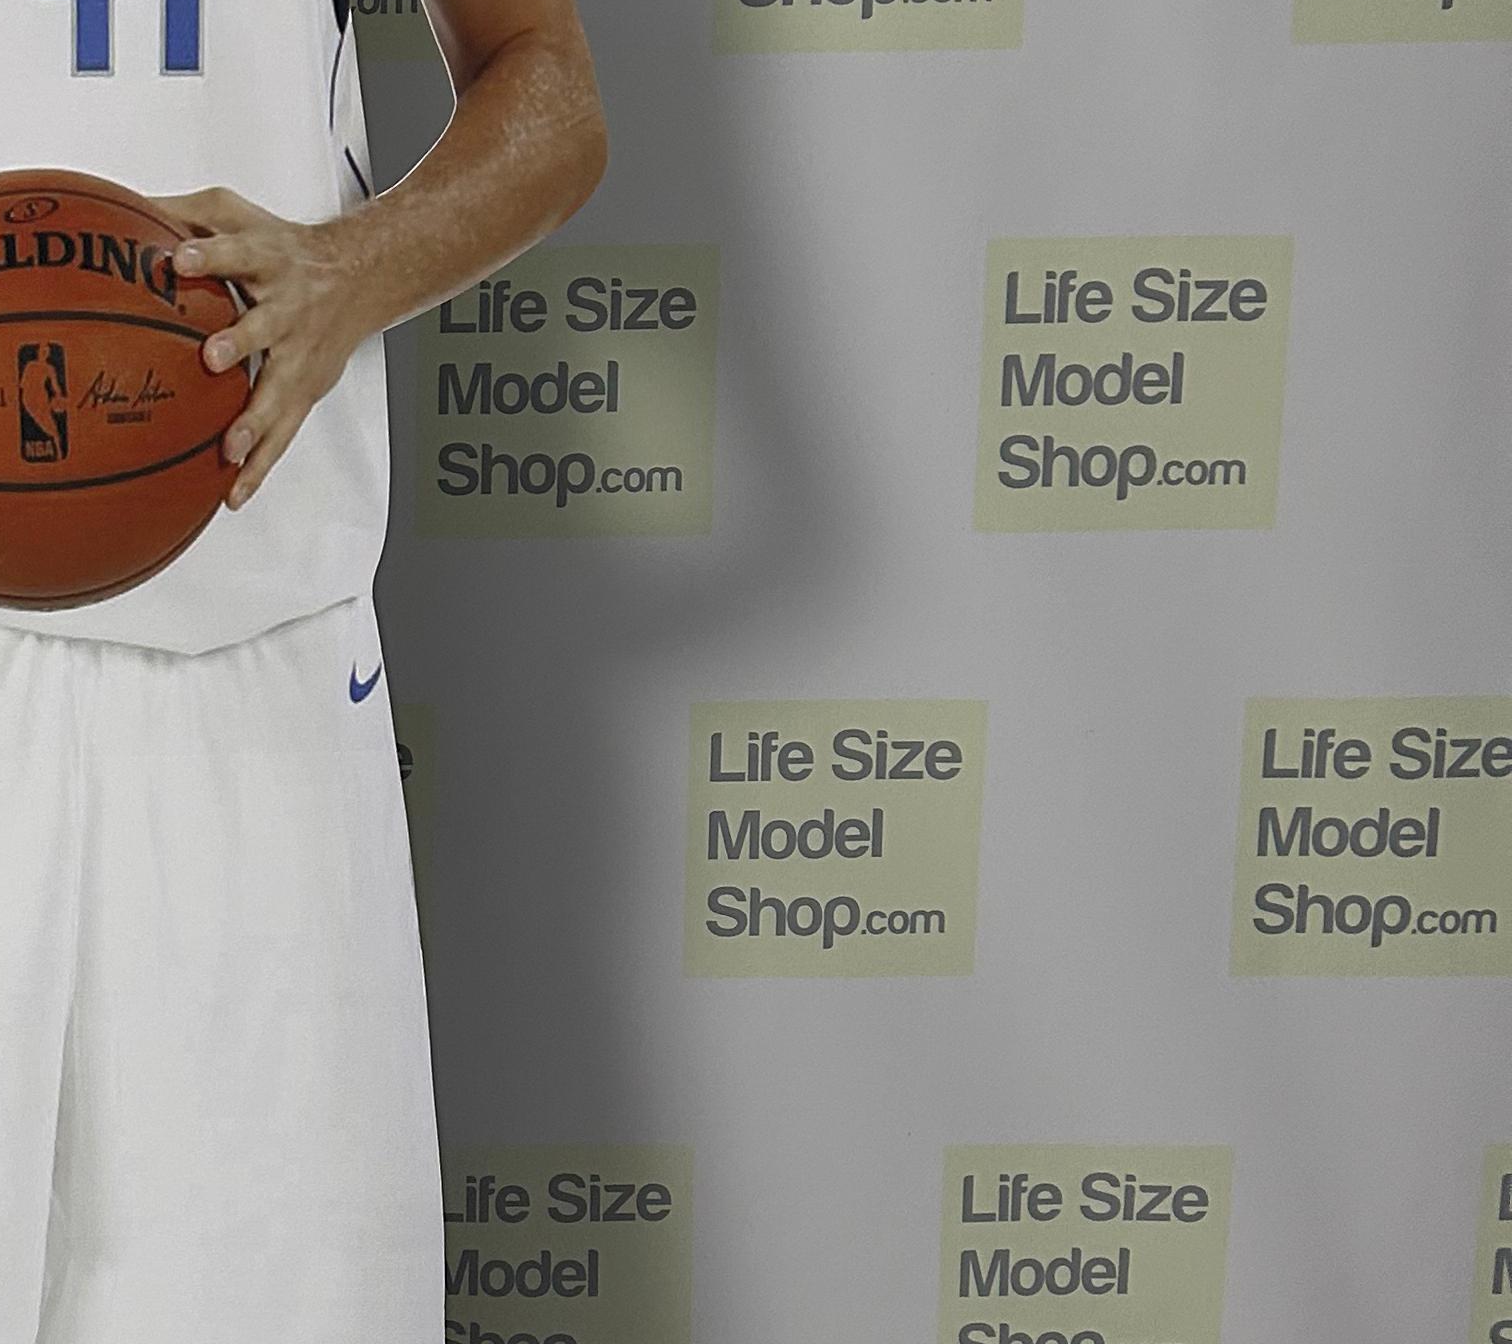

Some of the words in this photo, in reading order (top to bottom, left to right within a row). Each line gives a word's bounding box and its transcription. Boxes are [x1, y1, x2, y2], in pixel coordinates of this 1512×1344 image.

[440, 280, 548, 334] Life
[566, 277, 697, 332] Size
[1005, 270, 1113, 324] Life
[1131, 268, 1267, 323] Size
[438, 360, 619, 415] Model
[1001, 352, 1184, 407] Model
[437, 442, 682, 508] Shop.com
[998, 435, 1246, 501] Shop.com
[710, 732, 814, 782] Life
[831, 729, 962, 781] Size
[1262, 728, 1372, 779] Life
[1389, 727, 1512, 780] Size
[708, 808, 883, 860] Model
[1257, 807, 1440, 858] Model
[706, 886, 945, 949] Shop.com
[1253, 883, 1497, 948] Shop.com
[547, 1173, 672, 1223] Size
[962, 1174, 1063, 1223] Life
[1080, 1172, 1209, 1223] Size
[446, 1249, 599, 1297] Model
[959, 1247, 1130, 1297] Model
